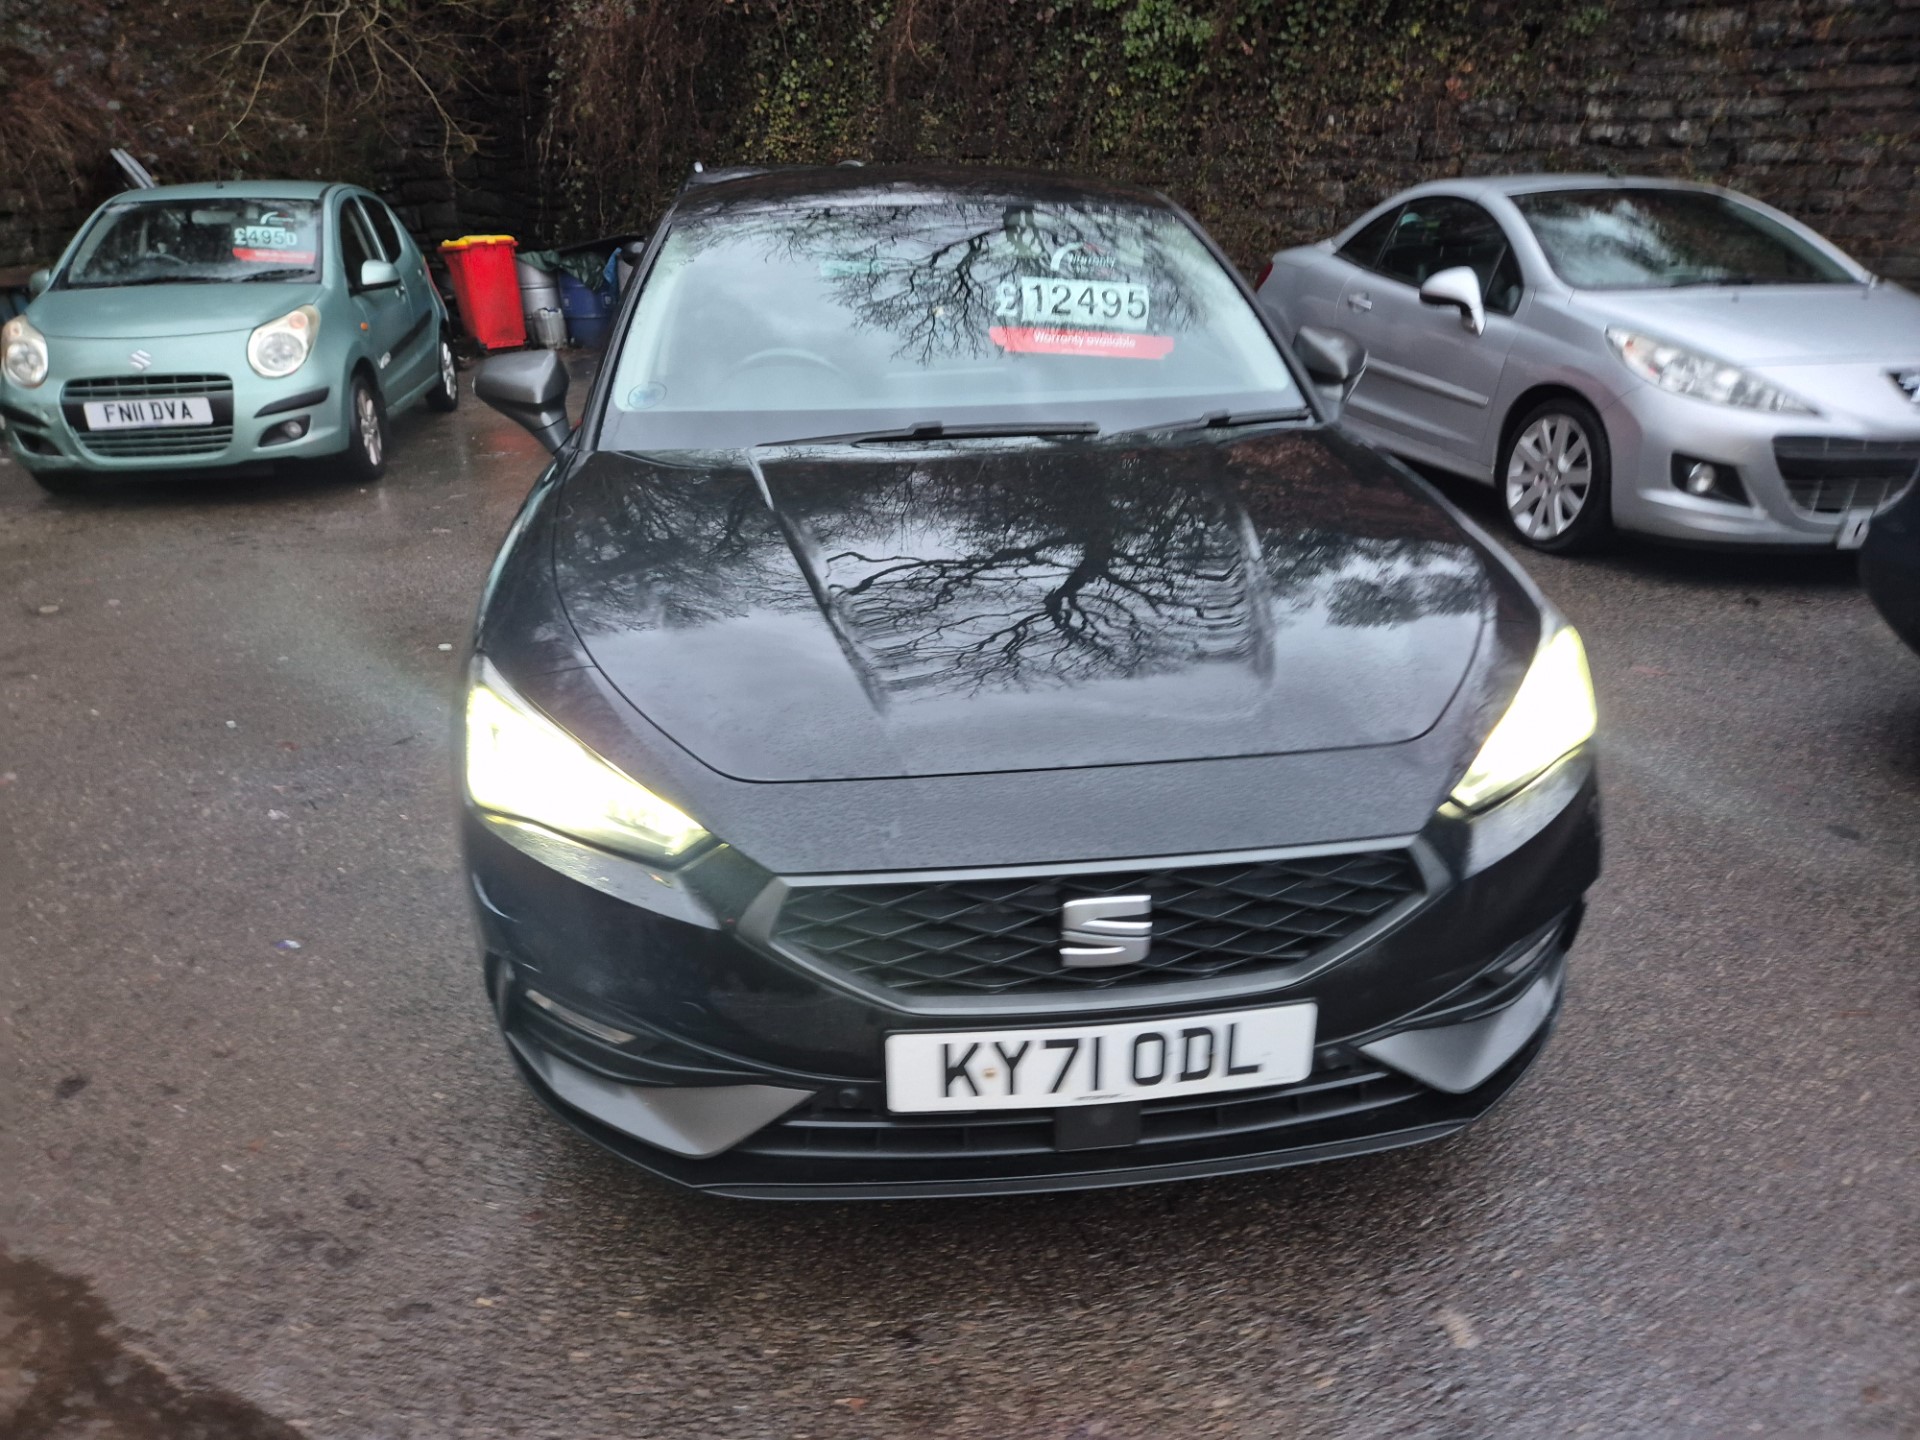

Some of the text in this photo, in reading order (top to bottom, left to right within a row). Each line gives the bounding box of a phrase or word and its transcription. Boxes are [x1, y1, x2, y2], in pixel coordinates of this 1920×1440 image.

[1033, 331, 1135, 347] Warranty available
[103, 401, 192, 422] FN11 DVA
[941, 1023, 1262, 1097] KY71 ODL
